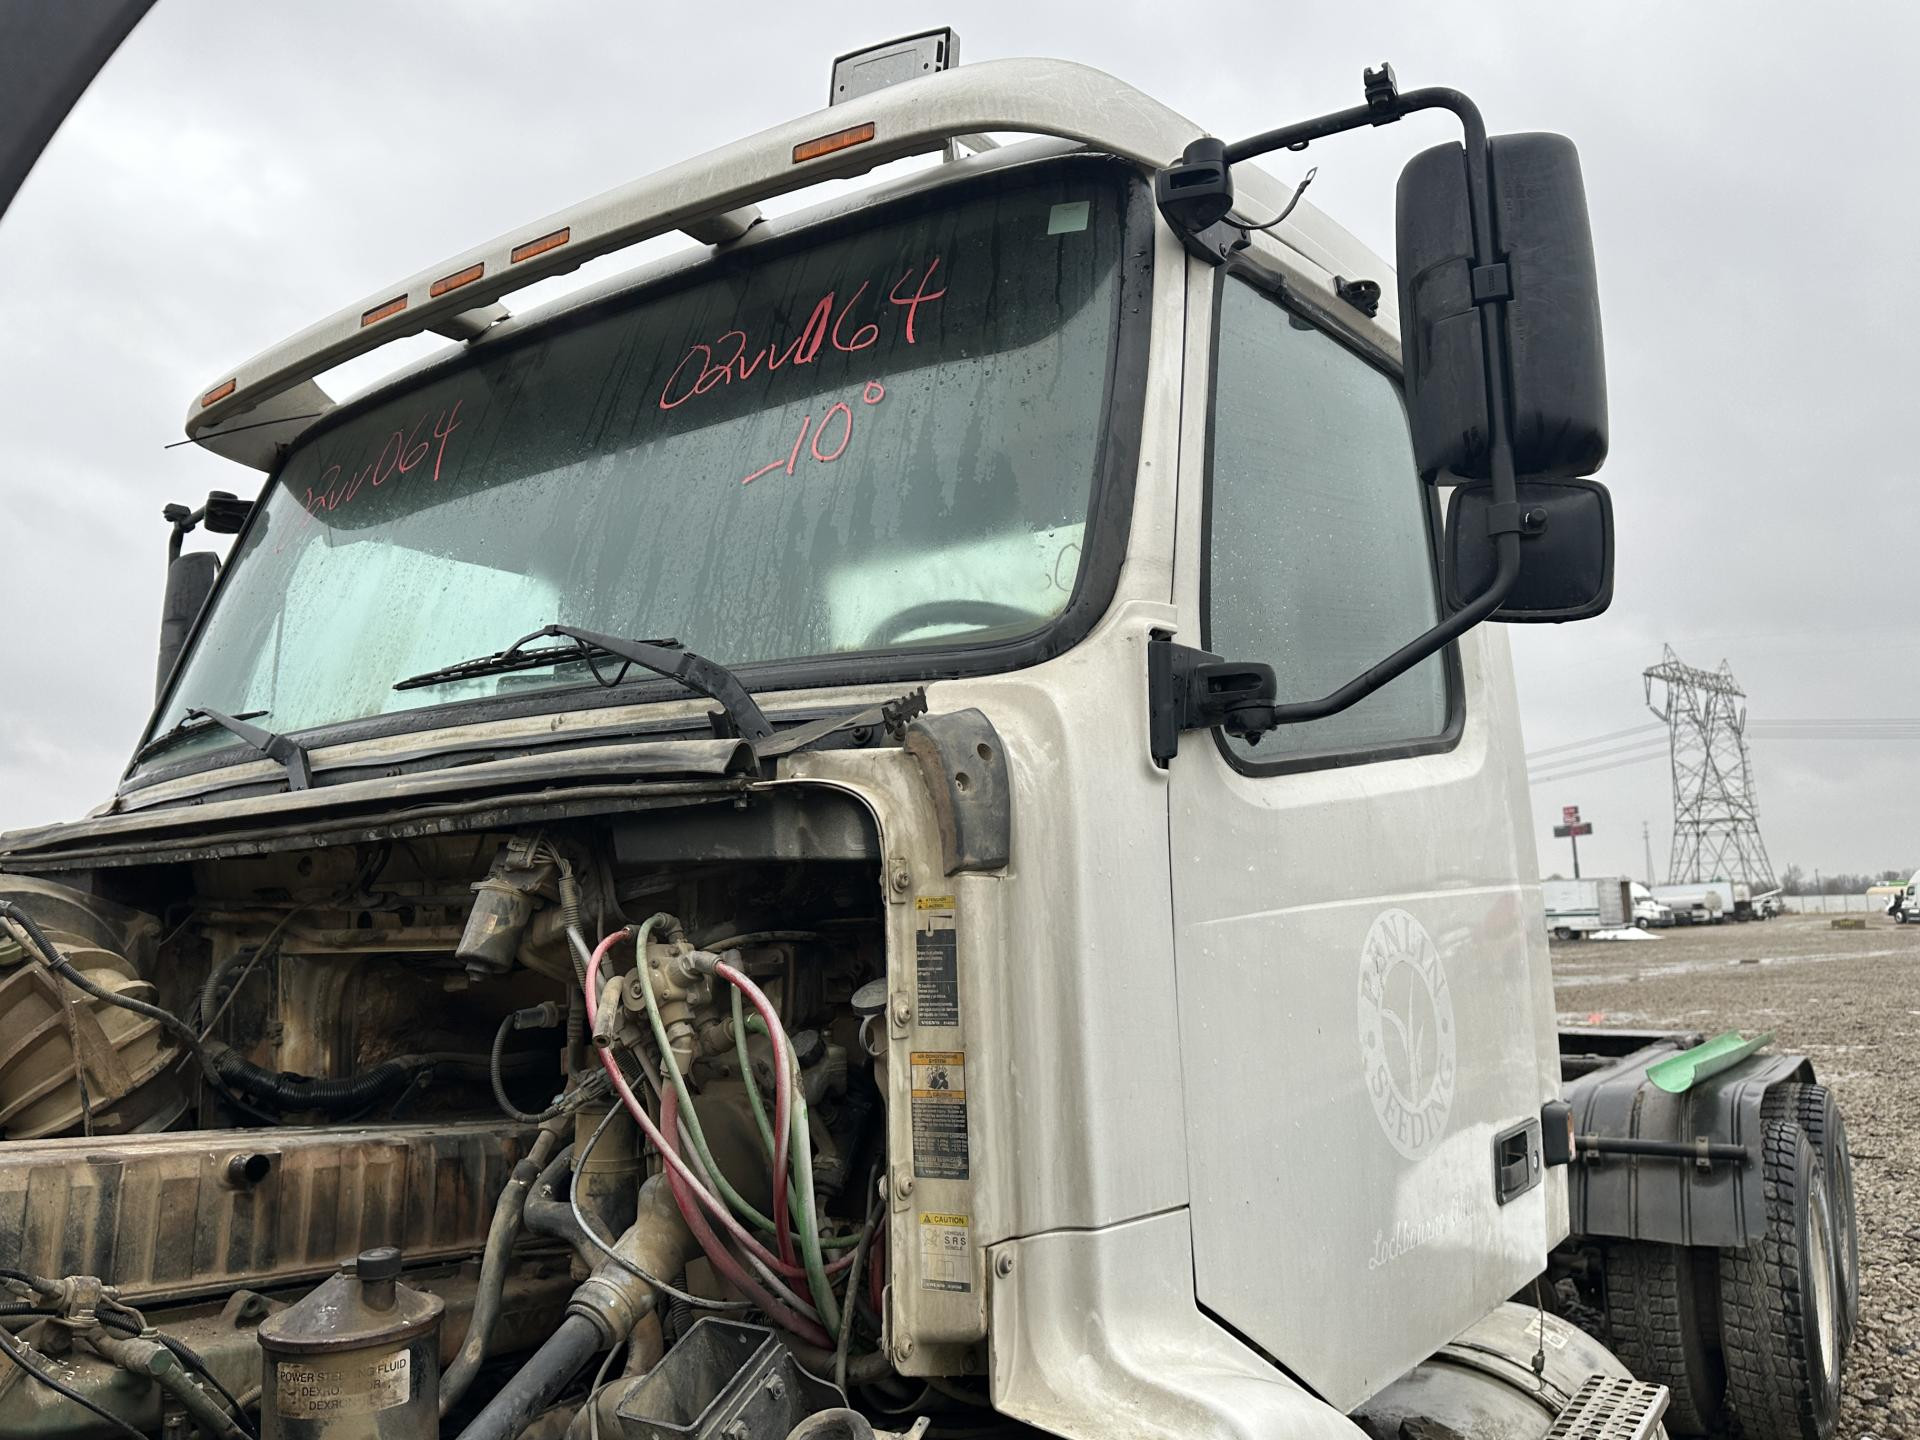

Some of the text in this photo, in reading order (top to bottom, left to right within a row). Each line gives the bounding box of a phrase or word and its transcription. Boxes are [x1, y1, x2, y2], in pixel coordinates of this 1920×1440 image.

[1370, 1053, 1453, 1150] SEEDING
[934, 1215, 964, 1225] CAUTION
[280, 1371, 315, 1383] POWER
[377, 1358, 407, 1374] FLUID
[301, 1386, 343, 1397] DEXRO
